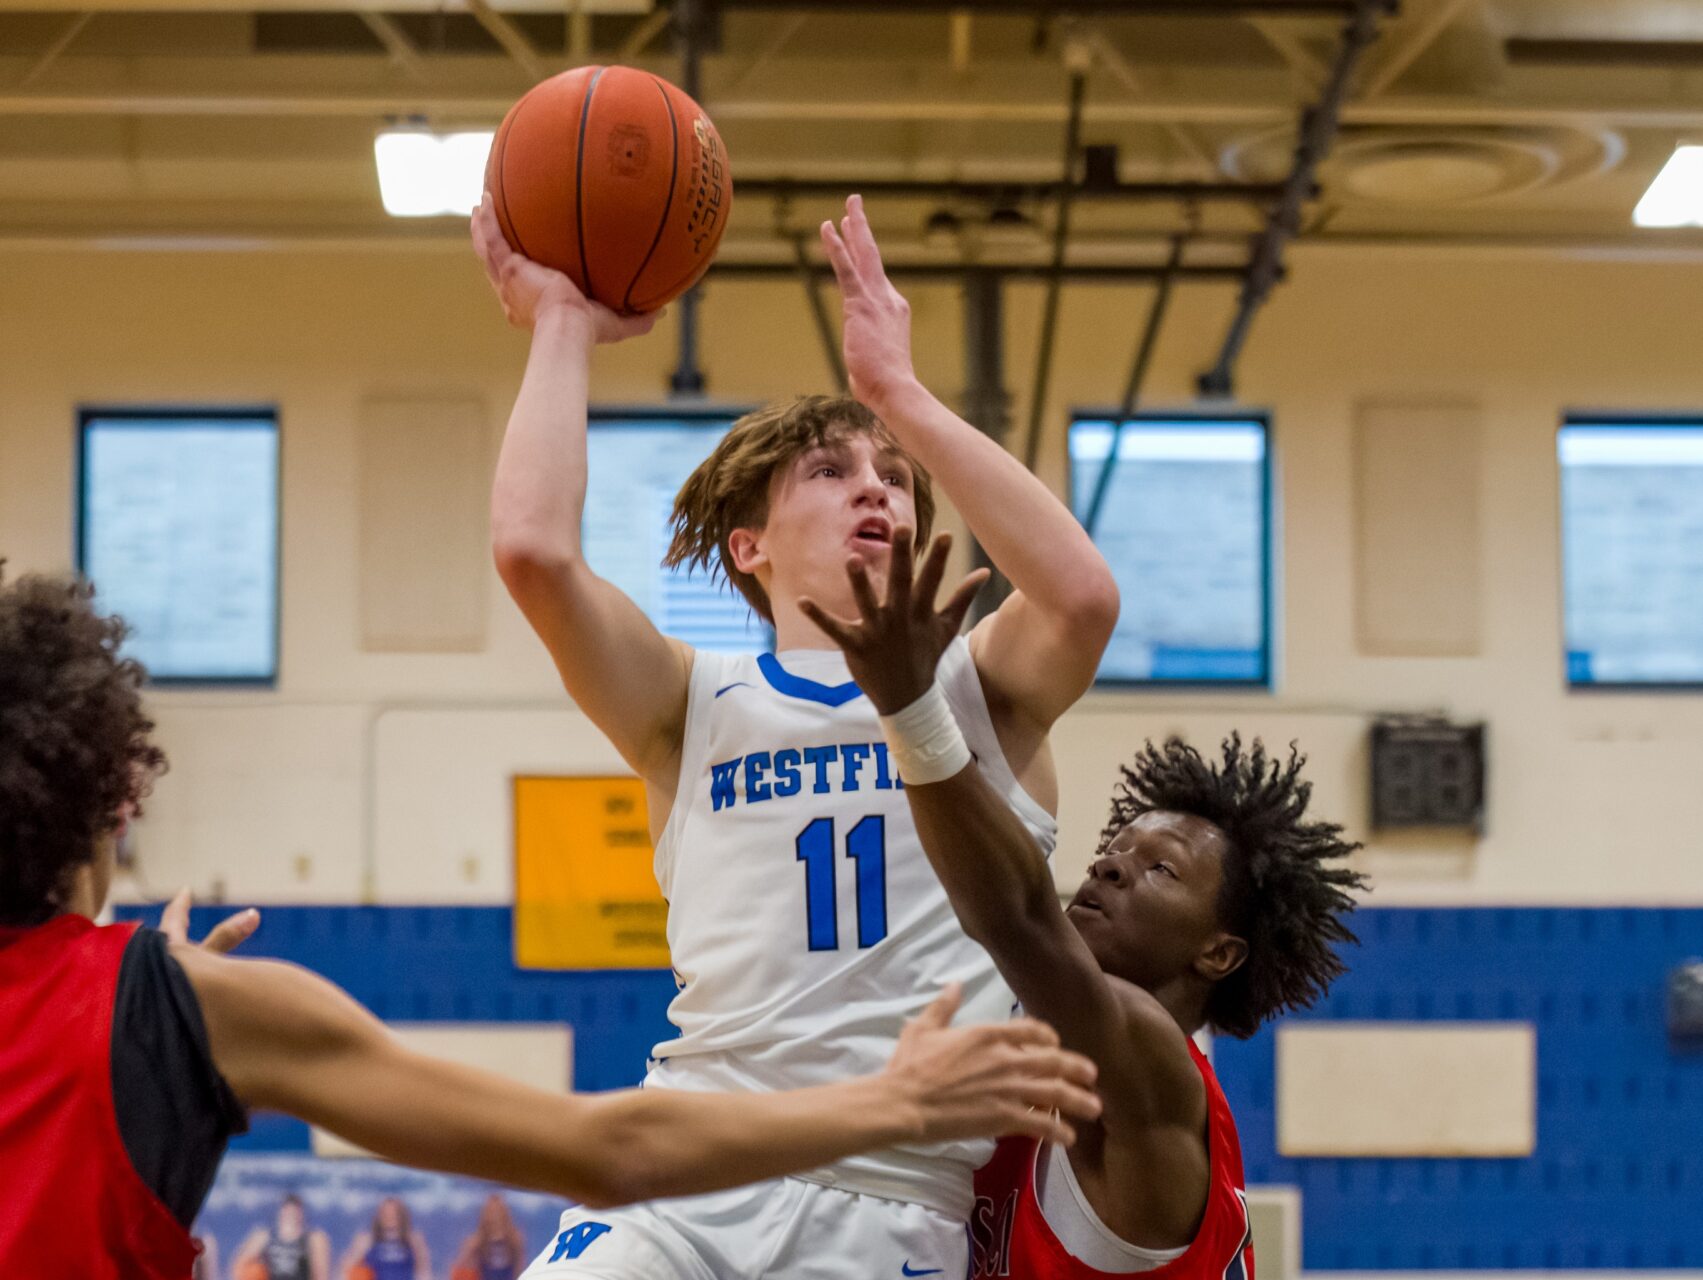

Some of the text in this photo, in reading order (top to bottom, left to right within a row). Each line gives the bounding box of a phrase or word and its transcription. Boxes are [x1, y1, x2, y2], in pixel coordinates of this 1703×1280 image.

[711, 742, 905, 812] WESTFI
[795, 814, 888, 952] 11
[547, 1221, 613, 1264] W
